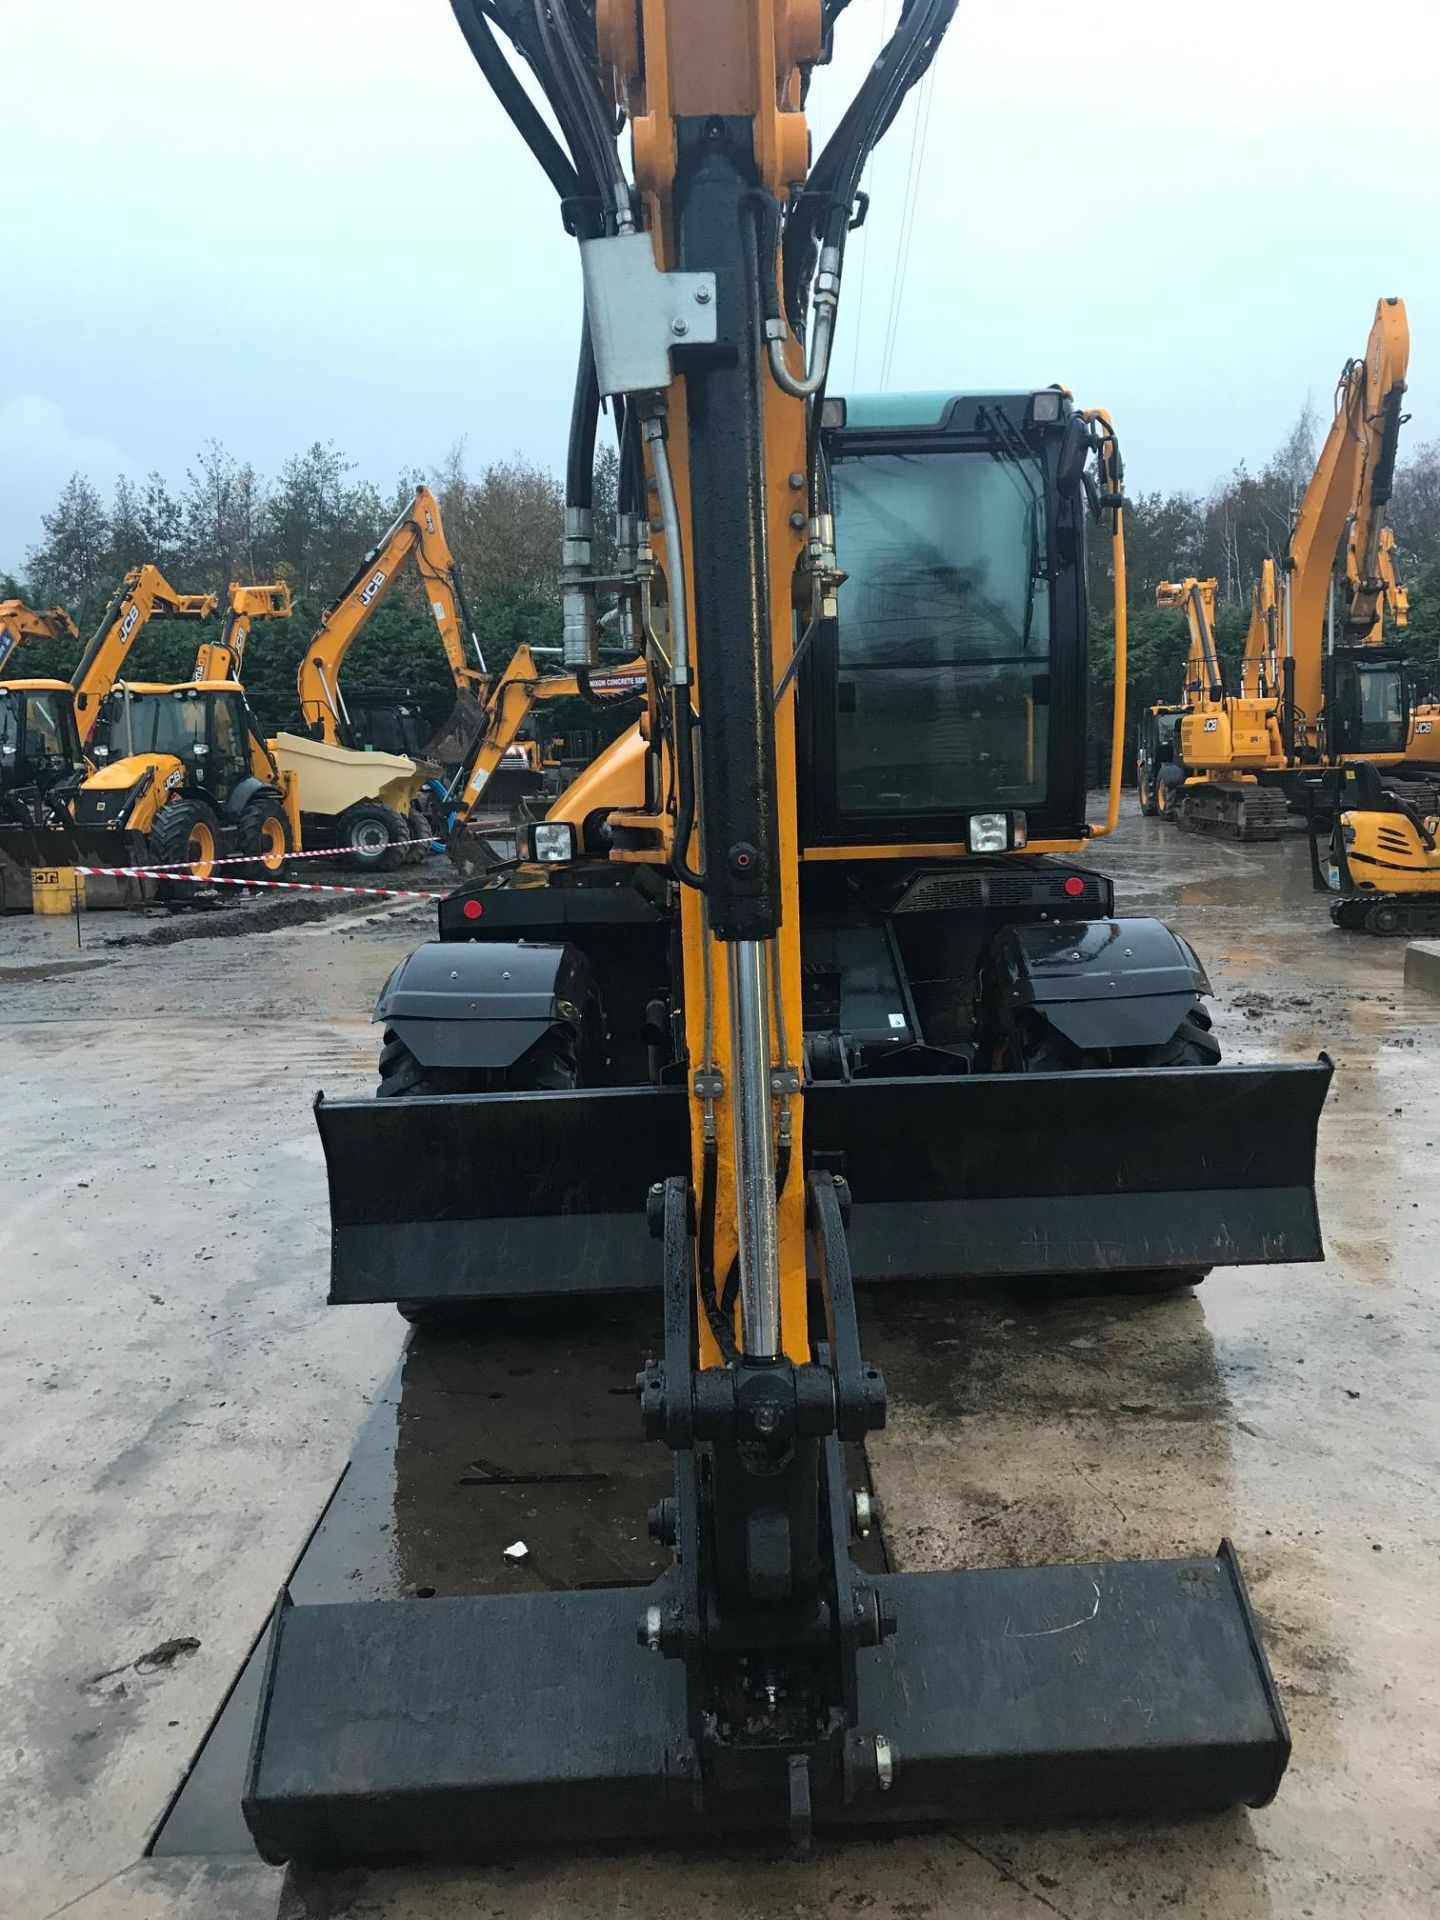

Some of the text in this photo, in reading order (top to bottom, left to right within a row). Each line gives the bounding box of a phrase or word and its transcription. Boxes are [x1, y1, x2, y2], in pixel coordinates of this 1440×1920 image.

[358, 571, 387, 606] JCB
[118, 604, 139, 643] JCB
[589, 679, 606, 688] NIXON
[606, 677, 634, 687] CONCRETE
[1204, 718, 1218, 731] JCB
[1415, 721, 1432, 733] JCB
[165, 769, 181, 791] JCB
